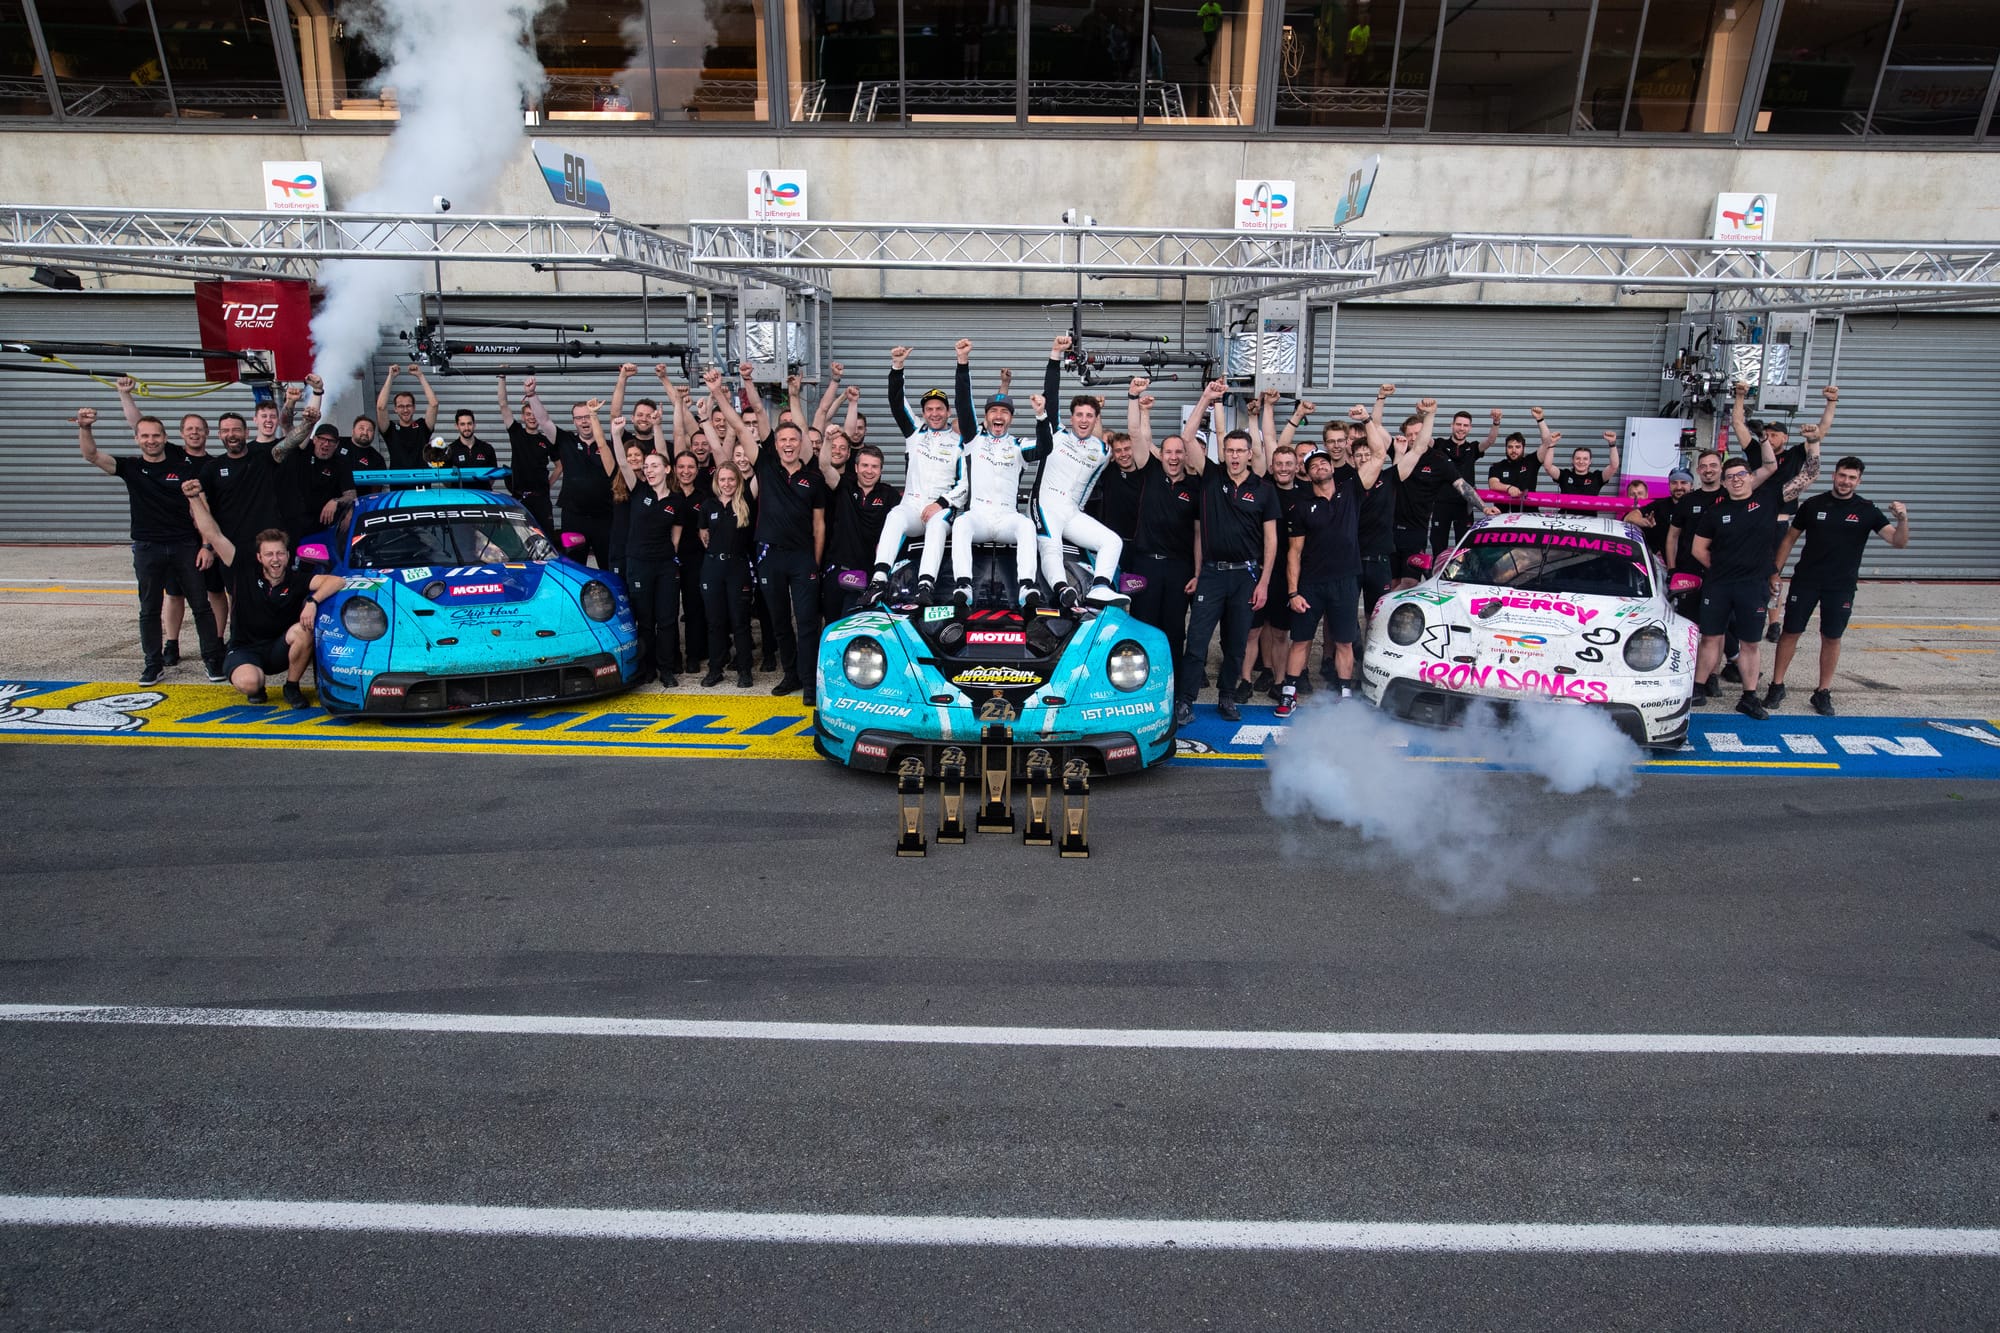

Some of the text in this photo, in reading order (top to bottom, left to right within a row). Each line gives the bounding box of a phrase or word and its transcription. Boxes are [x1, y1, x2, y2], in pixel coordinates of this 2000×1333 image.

[564, 153, 586, 204] 90
[1345, 168, 1362, 219] 92
[754, 210, 801, 218] ToalEnergies
[1242, 221, 1288, 229] TotalEnrgies
[222, 304, 279, 320] TDS
[475, 345, 520, 353] MANTHEY
[1663, 369, 1674, 379] 19
[1066, 453, 1096, 470] MANTHEY
[365, 511, 527, 528] PORSCHE
[1473, 532, 1537, 545] IRON
[1541, 534, 1633, 557] DAMES
[452, 584, 502, 595] MOTUL
[1508, 590, 1567, 600] TOTAL
[488, 607, 520, 616] Hart
[928, 611, 950, 619] GT3
[1470, 596, 1599, 625] ENERGY
[969, 633, 1024, 642] MOTUL
[1669, 648, 1681, 673] total
[331, 666, 374, 676] GOODYEAR
[596, 664, 617, 676] MOTUL
[961, 669, 1035, 678] MOUNTAIN
[953, 676, 1042, 684] MOTORSPORTS
[372, 687, 402, 696] MOTUL
[834, 697, 912, 718] 1ST PHORM
[1641, 697, 1681, 709] GOODYEAR
[980, 702, 1016, 721] 24h
[1081, 702, 1155, 720] 1ST PHORM
[821, 713, 857, 732] GOODYEAR
[857, 744, 887, 756] MOTUL
[1108, 747, 1136, 759] MOTUL
